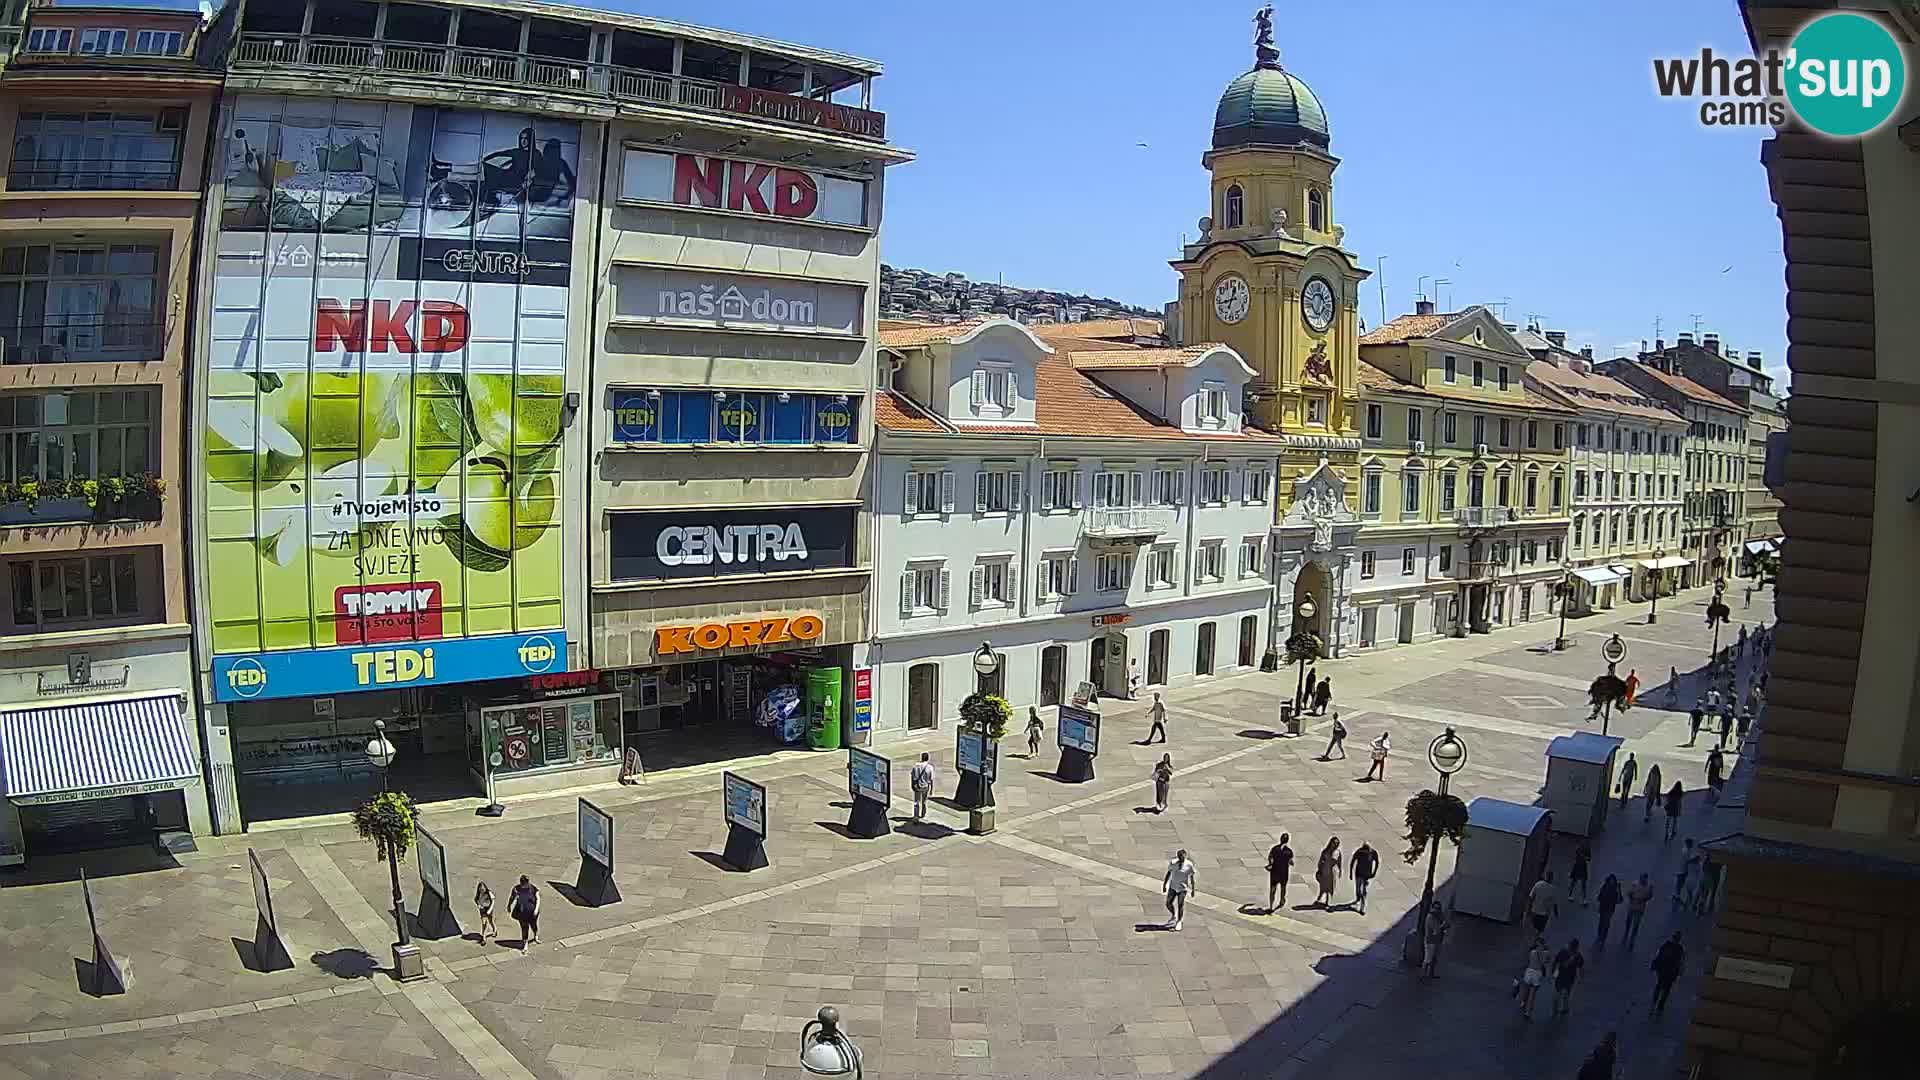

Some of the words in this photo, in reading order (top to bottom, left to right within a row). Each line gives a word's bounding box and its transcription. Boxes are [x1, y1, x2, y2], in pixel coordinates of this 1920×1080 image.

[673, 153, 818, 219] NKD
[443, 248, 530, 275] CENTRA
[658, 283, 716, 316] naš
[751, 290, 815, 324] dom
[314, 297, 472, 354] NKD
[616, 407, 655, 426] TEDi
[720, 409, 757, 427] TEDi
[818, 411, 851, 428] TEDi
[332, 497, 442, 518] #TvojeMisto
[327, 529, 352, 551] ZA
[360, 525, 446, 549] DNEVNO
[656, 522, 808, 566] CENTRA
[353, 548, 421, 577] SVJEŽE
[342, 588, 434, 617] TOMMY
[397, 612, 429, 626] VOIŠ.
[655, 614, 824, 655] KORZO
[351, 647, 436, 687] TEDi
[517, 644, 556, 664] TEDi
[226, 668, 268, 687] TEDi
